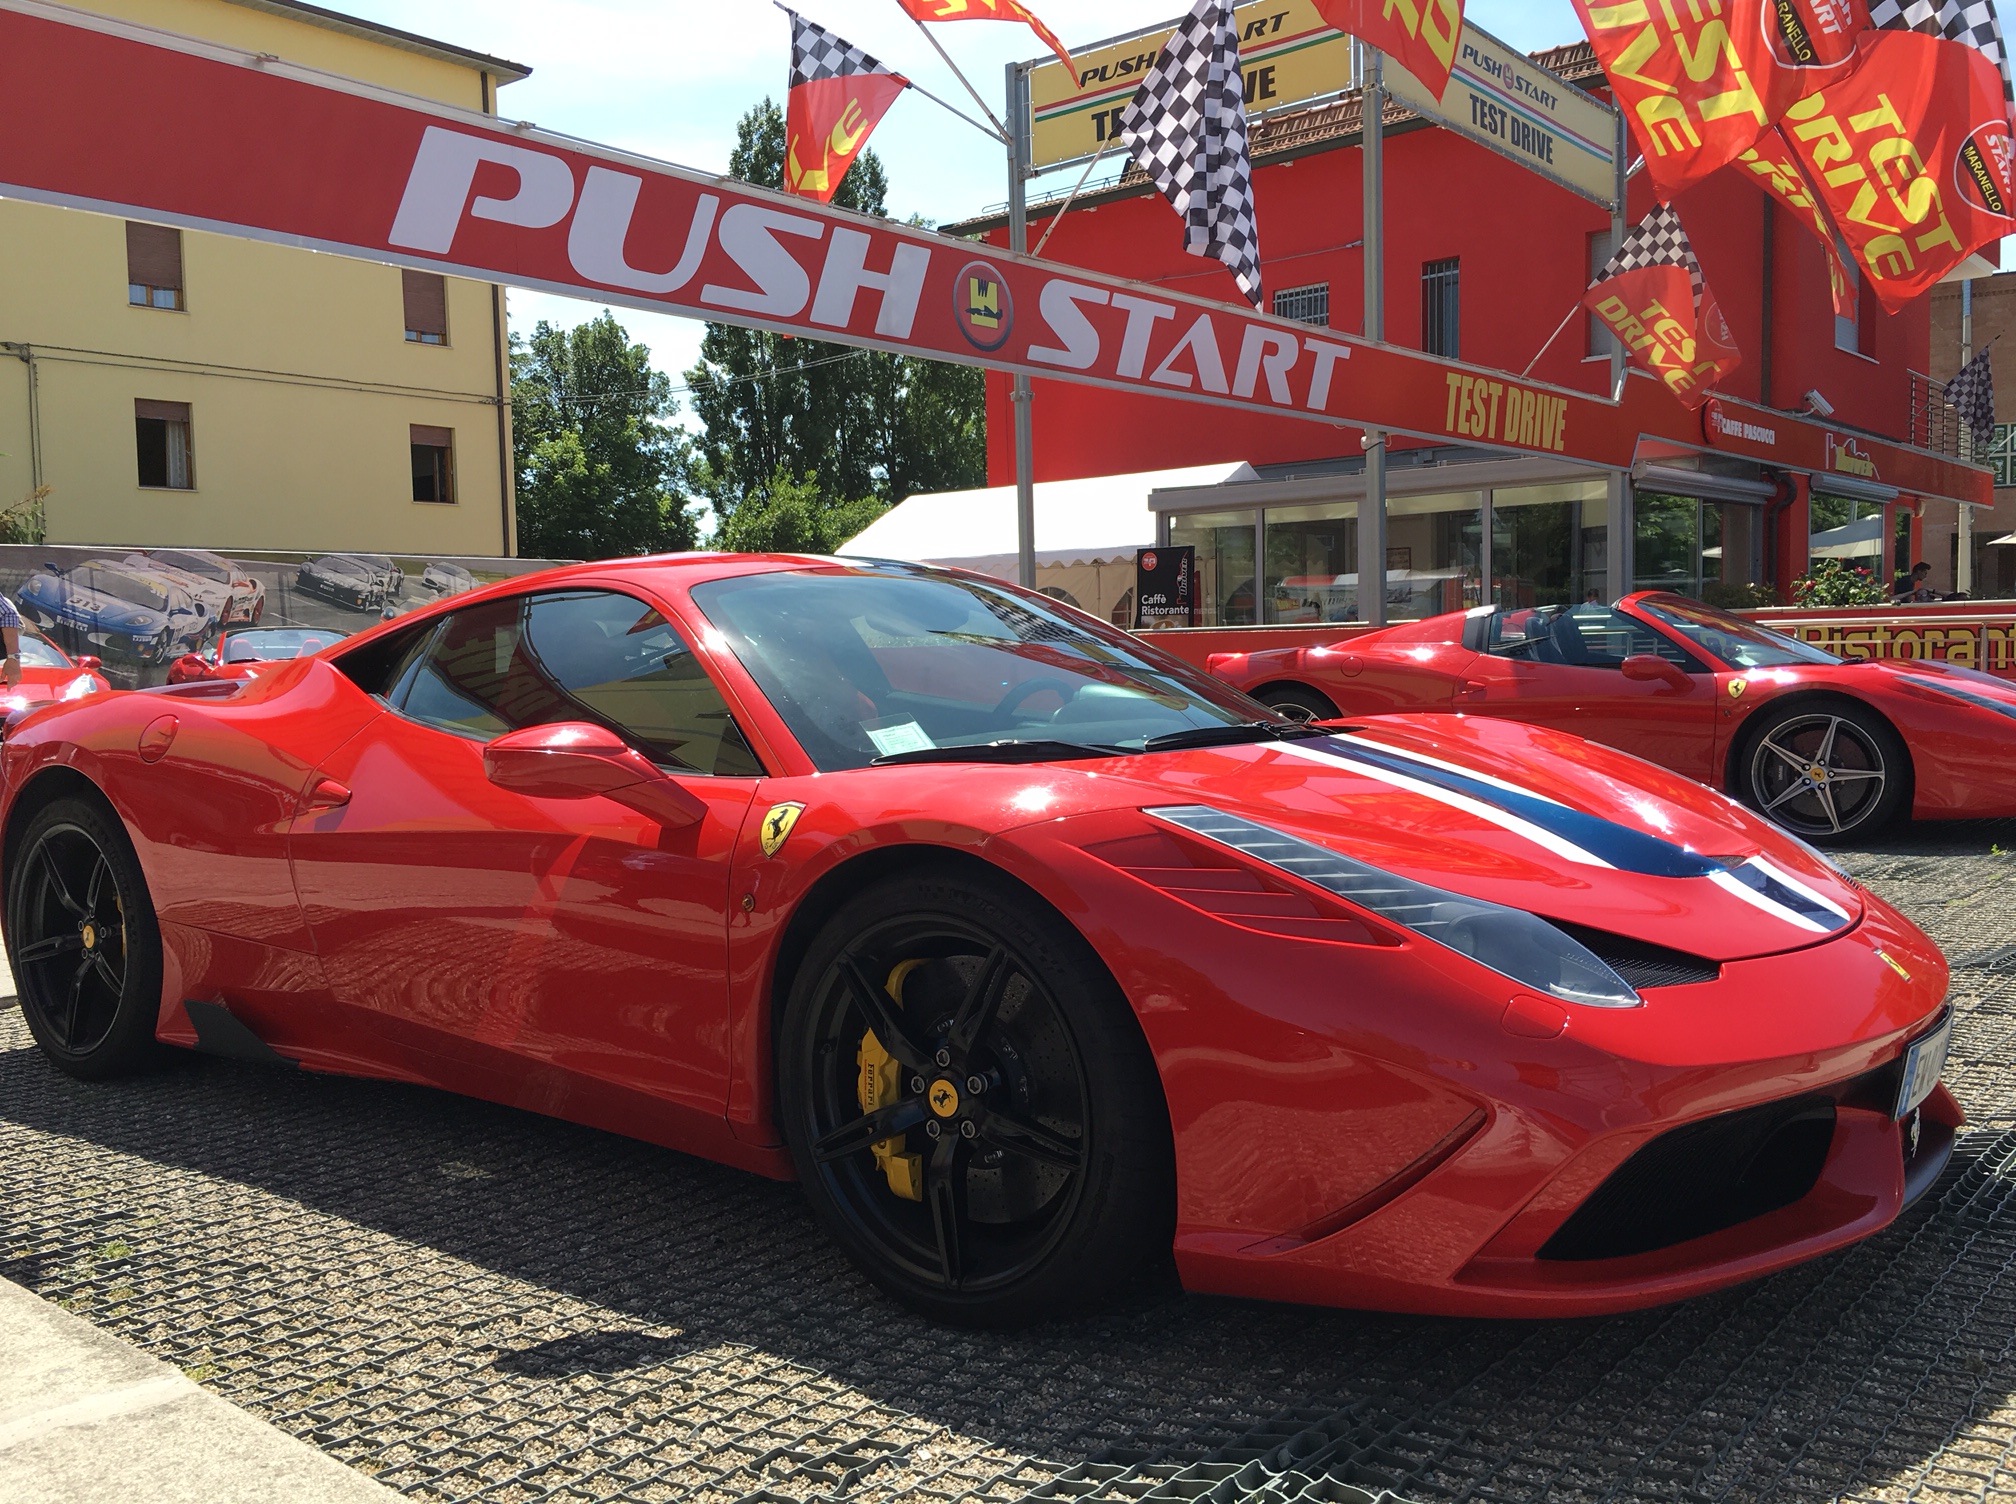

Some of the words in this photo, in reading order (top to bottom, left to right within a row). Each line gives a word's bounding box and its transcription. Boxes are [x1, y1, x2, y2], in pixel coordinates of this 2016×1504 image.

[1778, 0, 1811, 61] RANELLO
[1080, 51, 1157, 88] PUSH
[1462, 43, 1503, 79] PUSH
[1514, 75, 1558, 111] START
[1587, 0, 1702, 157] IVE
[1469, 93, 1507, 139] TEST
[1511, 115, 1553, 165] DRIVE
[1847, 93, 1963, 253] TEST
[1963, 145, 2002, 211] MARANELLO
[387, 125, 932, 340] PUSH
[1026, 279, 1351, 411] START
[1595, 295, 1697, 395] DRIVE
[1446, 372, 1503, 439] TEST
[1504, 386, 1568, 451] DRIVE
[1743, 423, 1775, 445] PASCUCCI
[1141, 594, 1167, 605] Caffè
[1141, 606, 1190, 615] Ristorante
[867, 1064, 875, 1106] Ferrari
